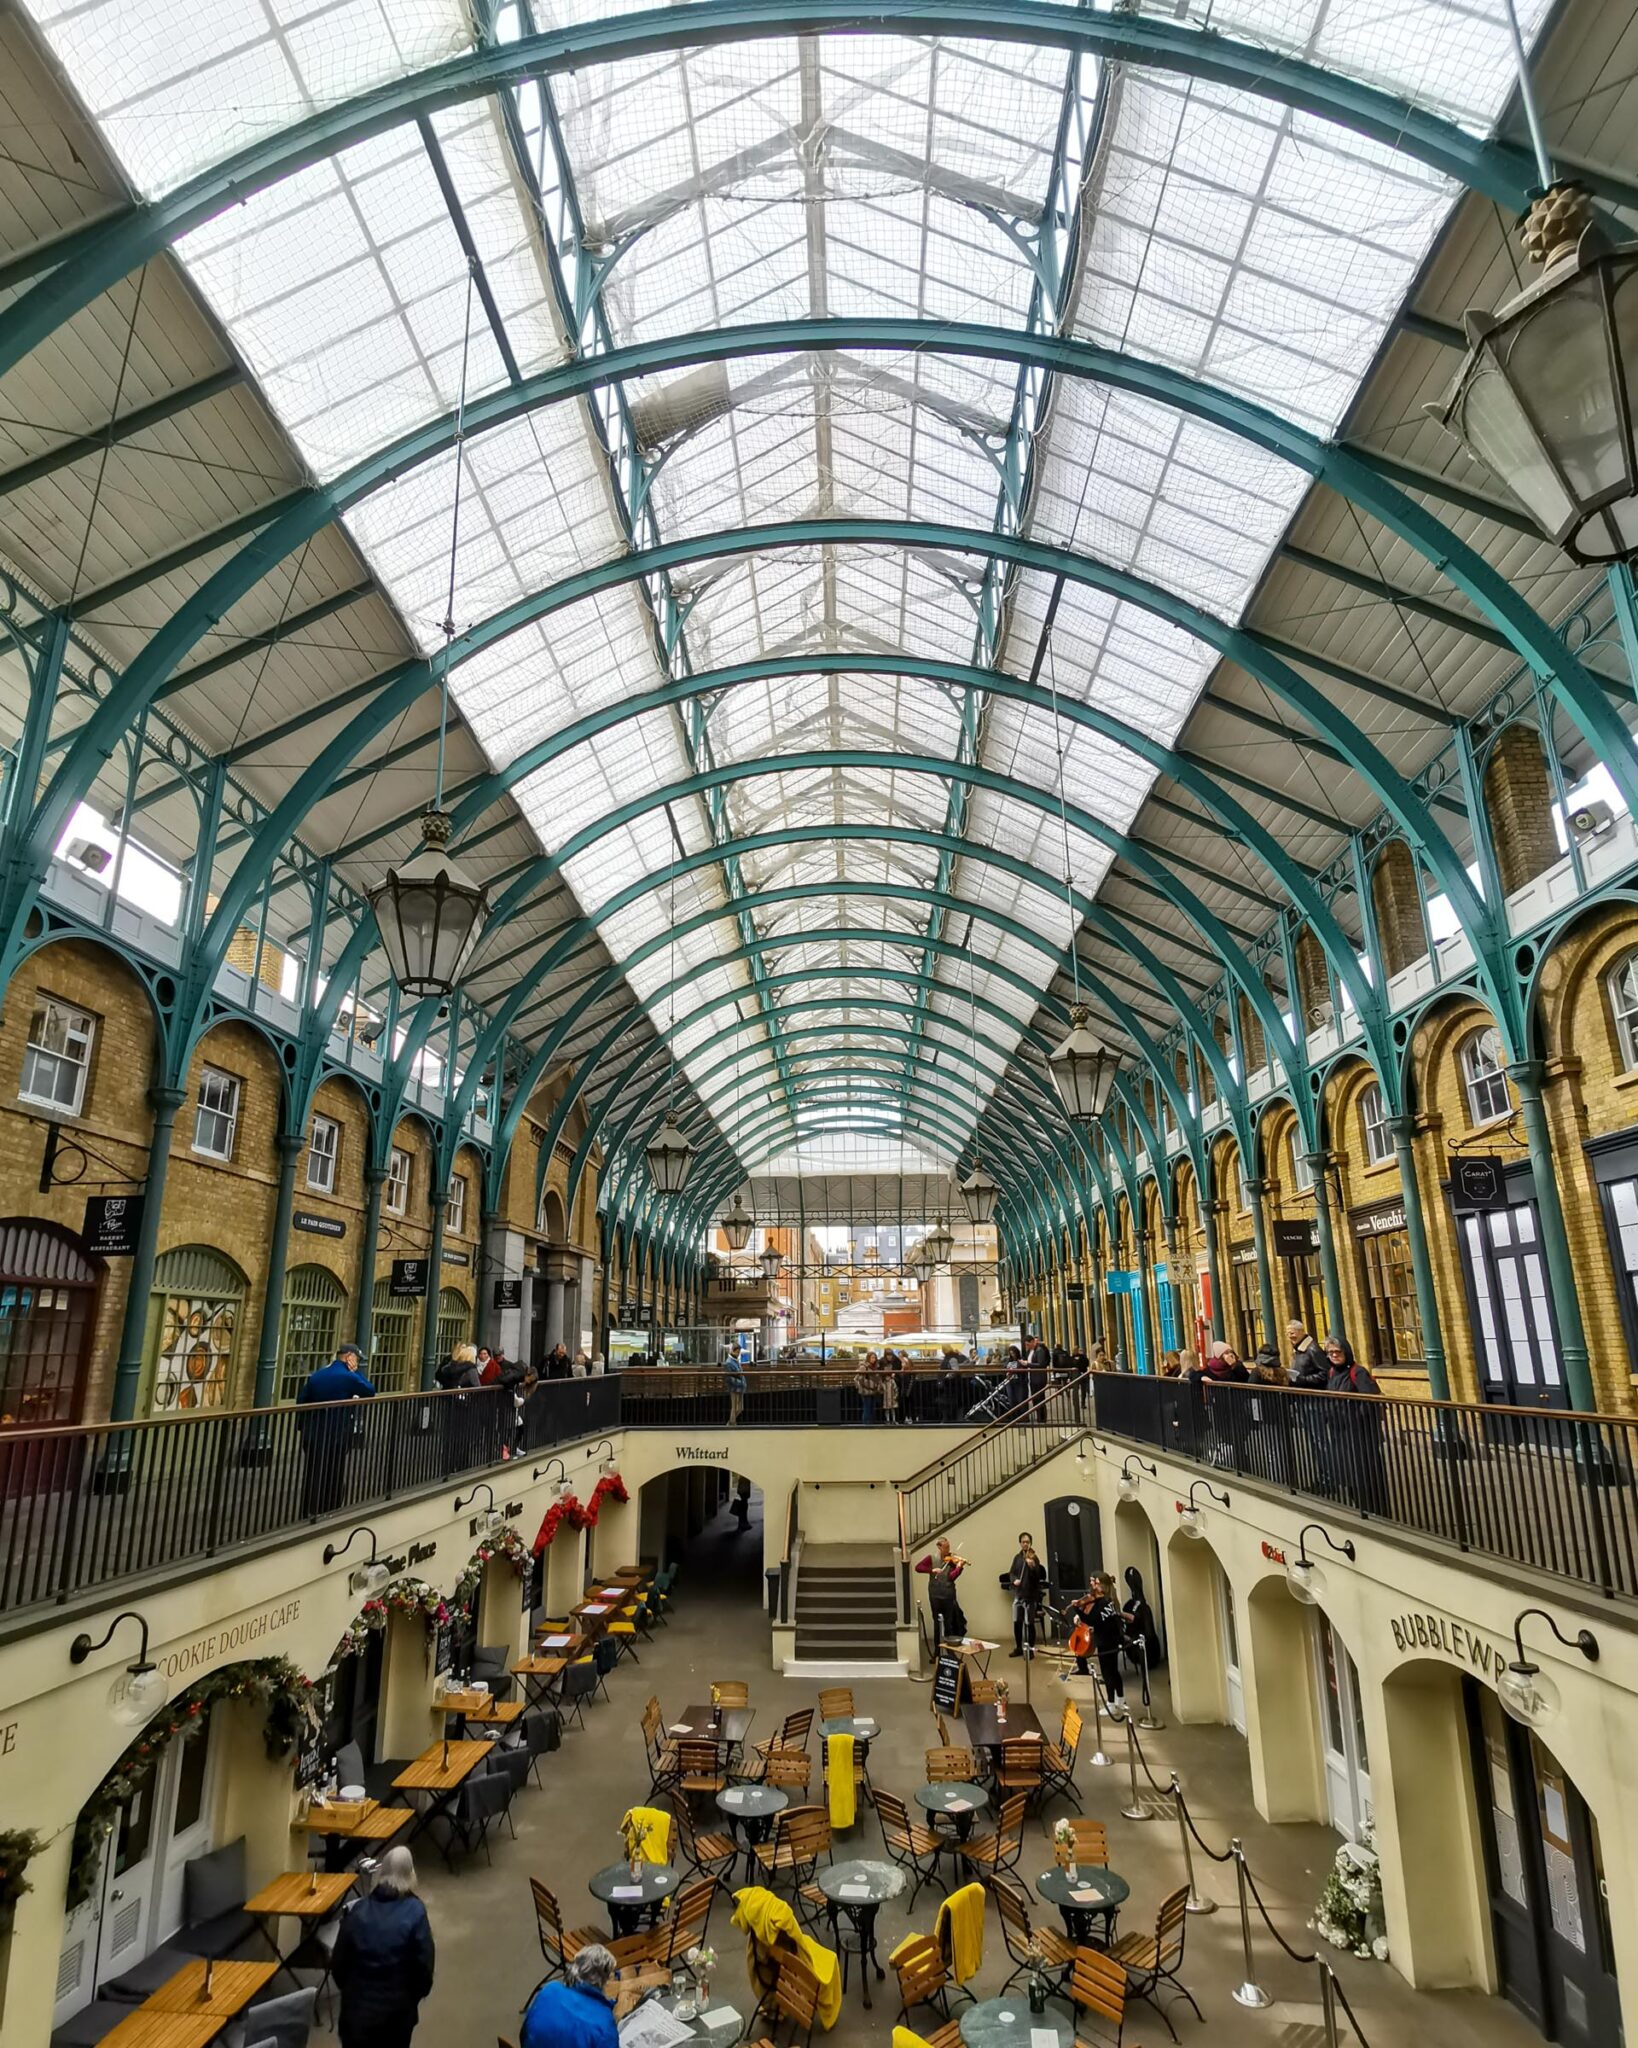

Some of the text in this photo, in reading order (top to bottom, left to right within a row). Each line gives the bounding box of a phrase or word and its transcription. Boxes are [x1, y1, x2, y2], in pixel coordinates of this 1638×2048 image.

[1464, 1170, 1490, 1178] CARAT
[1369, 1209, 1404, 1231] Venchi
[1240, 1247, 1258, 1262] Vench
[675, 1446, 729, 1460] Whittard
[407, 1541, 437, 1568] Place
[219, 1614, 268, 1655] DOUGH
[270, 1600, 301, 1631] CAFE
[1390, 1613, 1530, 1704] BUBBLEWR
